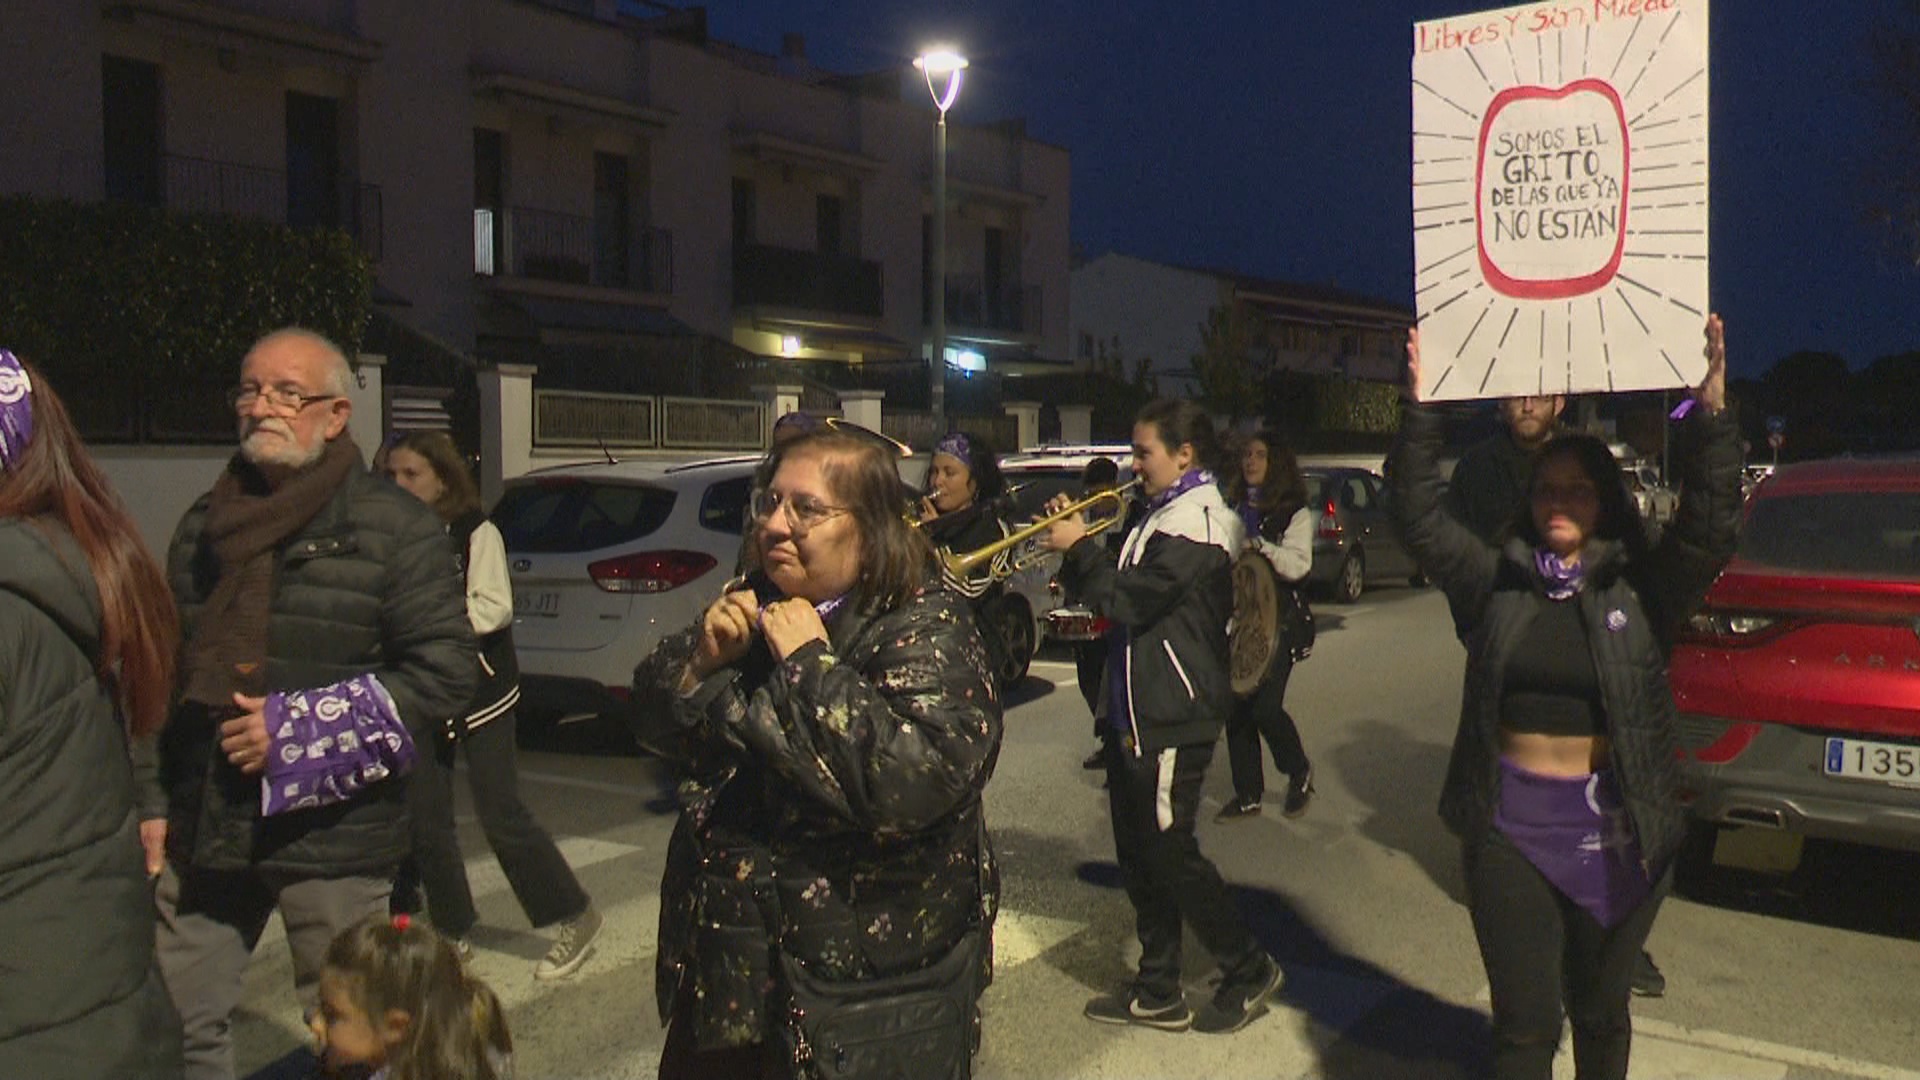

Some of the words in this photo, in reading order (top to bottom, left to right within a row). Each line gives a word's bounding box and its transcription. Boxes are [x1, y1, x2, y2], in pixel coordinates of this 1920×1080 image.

[1420, 22, 1499, 52] Libres
[1495, 128, 1565, 156] SOMOS
[1576, 123, 1608, 146] EL
[1503, 150, 1600, 184] GRITO
[1492, 187, 1515, 206] DE
[1518, 186, 1549, 205] LAS
[1556, 183, 1589, 202] QUE
[1593, 175, 1619, 198] YA
[1494, 210, 1530, 242] NO
[1538, 204, 1616, 240] ESTÁN
[1856, 747, 1920, 777] 135
